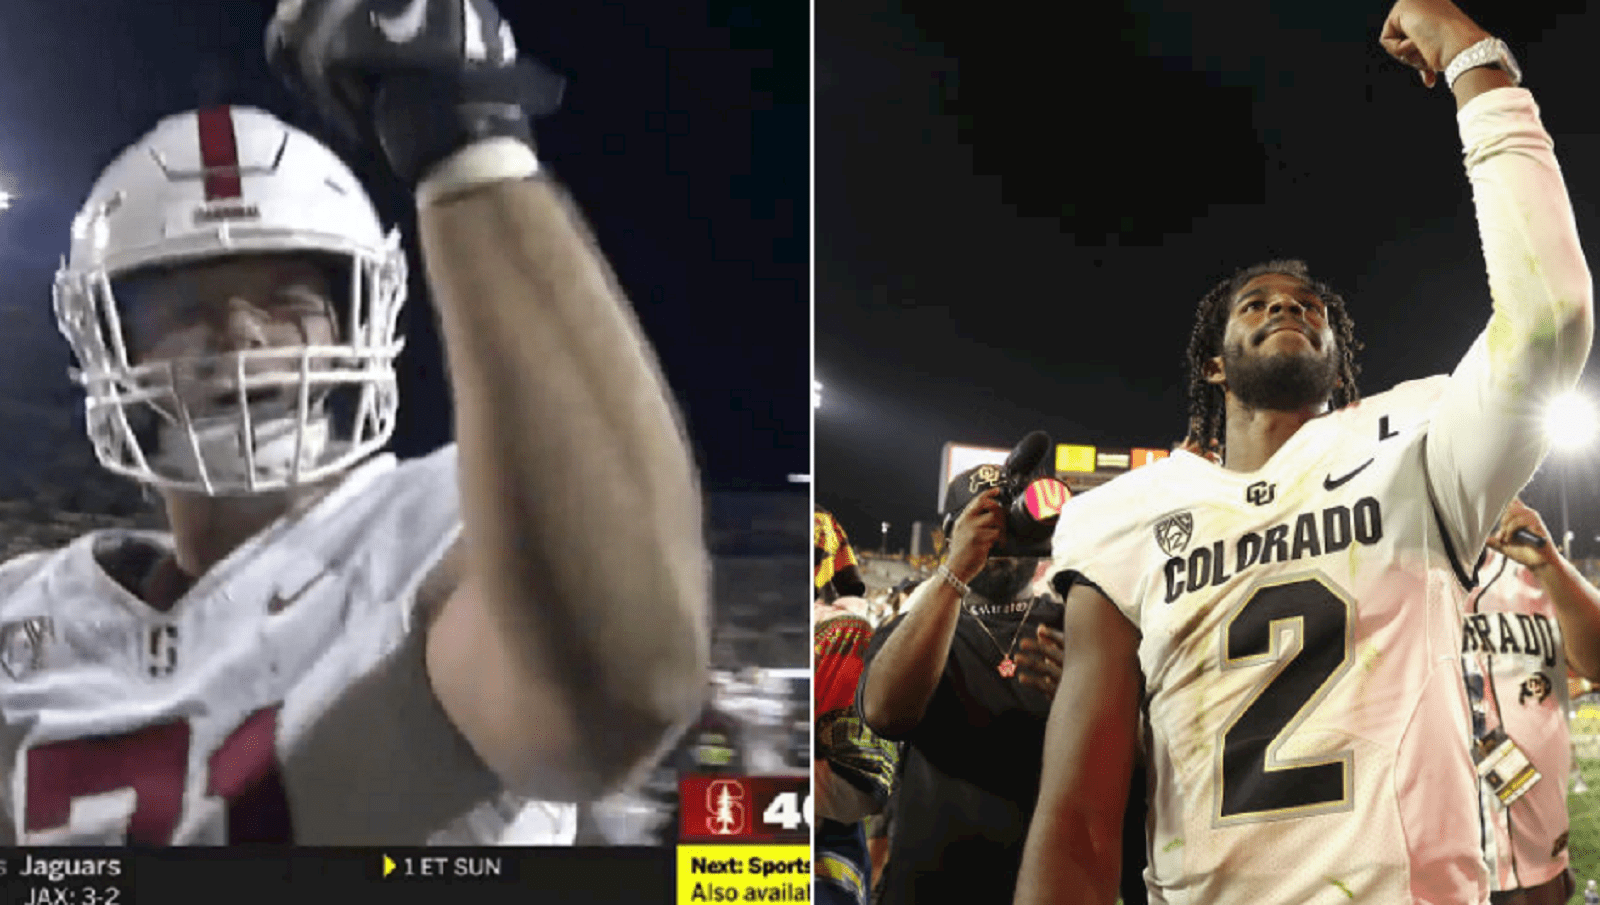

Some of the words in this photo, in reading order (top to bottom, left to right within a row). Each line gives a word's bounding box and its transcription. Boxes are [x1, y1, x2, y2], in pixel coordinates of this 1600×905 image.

[1379, 414, 1399, 441] L
[1164, 496, 1384, 604] COLORADO
[1212, 568, 1357, 829] 2
